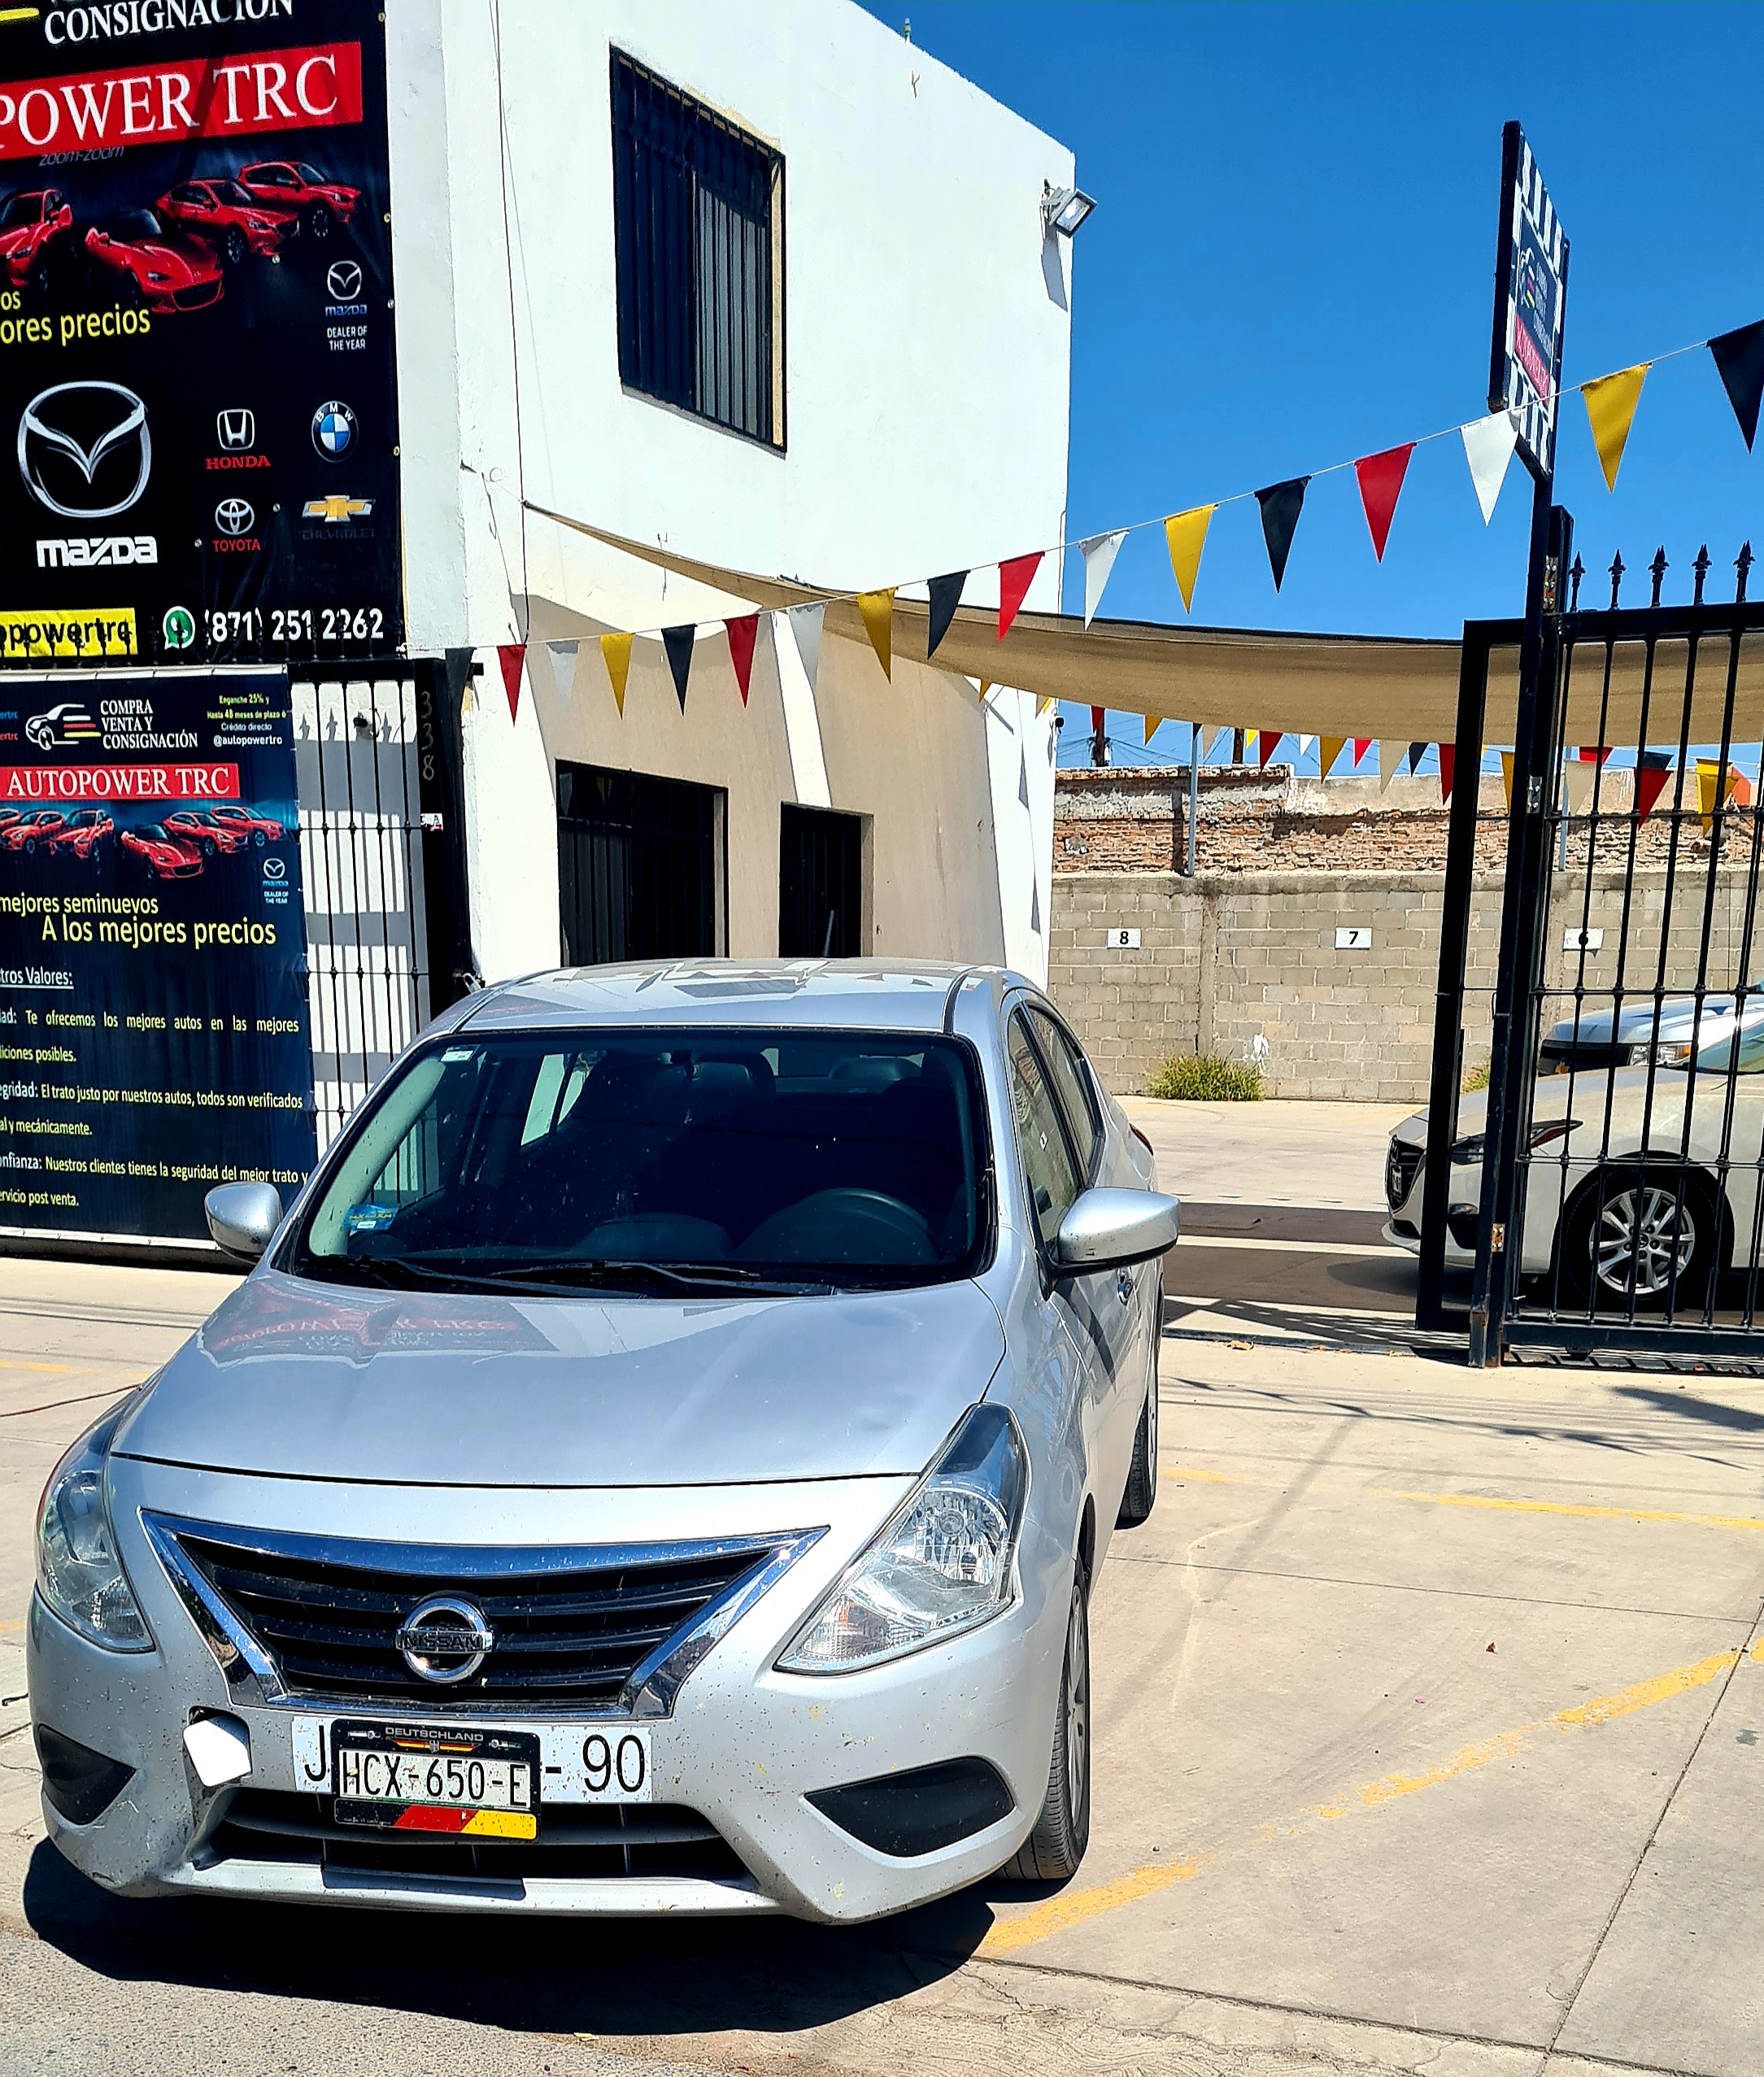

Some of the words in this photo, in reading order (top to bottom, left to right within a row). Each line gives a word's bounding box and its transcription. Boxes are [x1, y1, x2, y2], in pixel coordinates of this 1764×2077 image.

[213, 54, 338, 125] TRC
[0, 290, 21, 311] os
[325, 304, 368, 316] mazda
[0, 316, 53, 345] ores
[60, 303, 151, 347] precios
[327, 326, 356, 338] DEALER
[358, 325, 368, 337] OF
[329, 339, 344, 351] THE
[345, 338, 365, 351] YEAR
[315, 403, 354, 423] BMW
[206, 455, 271, 469] HONDA
[36, 536, 158, 567] mazda
[212, 538, 261, 552] TOYOTA
[271, 609, 311, 641] 251
[321, 607, 384, 640] 2262
[100, 699, 153, 715] COMPRA
[102, 716, 142, 732] VENTA
[145, 716, 154, 729] Y
[221, 721, 246, 731] Crédito
[248, 722, 272, 731] directo
[103, 729, 198, 750] CONSIGNACIÓN
[7, 769, 172, 797] AUTOPOWER
[176, 767, 230, 795] TRC
[0, 891, 60, 917] mejores
[63, 892, 159, 914] seminuevos
[42, 915, 57, 941] A
[63, 913, 93, 942] los
[99, 915, 186, 949] mejores
[194, 917, 277, 950] precios
[1119, 931, 1129, 945] 8
[1349, 931, 1359, 945] 7
[0, 967, 24, 984] tros
[25, 965, 73, 986] Valores:
[0, 1007, 16, 1024] ad:
[25, 1009, 38, 1025] Te
[46, 1009, 96, 1027] ofrecemos
[103, 1011, 119, 1028] los
[126, 1012, 166, 1032] mejores
[174, 1016, 203, 1030] autos
[211, 1018, 224, 1031] en
[233, 1015, 246, 1031] las
[256, 1017, 299, 1034] mejores
[0, 1044, 33, 1060] iciones
[36, 1046, 76, 1064] posibles.
[41, 1083, 50, 1098] El
[51, 1085, 76, 1099] trato
[76, 1085, 100, 1103] justo
[102, 1091, 119, 1106] por
[122, 1090, 163, 1104] nuestros
[164, 1091, 195, 1108] autos,
[197, 1091, 225, 1107] todos
[227, 1095, 245, 1108] son
[247, 1092, 303, 1109] verificados
[8, 1121, 15, 1134] y
[16, 1117, 93, 1135] mecánicamente.
[46, 1156, 87, 1173] Nuestros
[89, 1158, 125, 1175] clientes
[128, 1159, 156, 1176] tienes
[159, 1161, 168, 1177] la
[171, 1163, 219, 1182] seguridad
[221, 1165, 237, 1181] del
[272, 1169, 298, 1183] trato
[301, 1172, 308, 1184] y
[28, 1191, 49, 1207] post
[50, 1192, 80, 1206] venta.
[405, 1633, 481, 1649] NISSAN
[385, 1726, 484, 1742] DEUTSCHLAND
[342, 1751, 528, 1808] HCX-650-E
